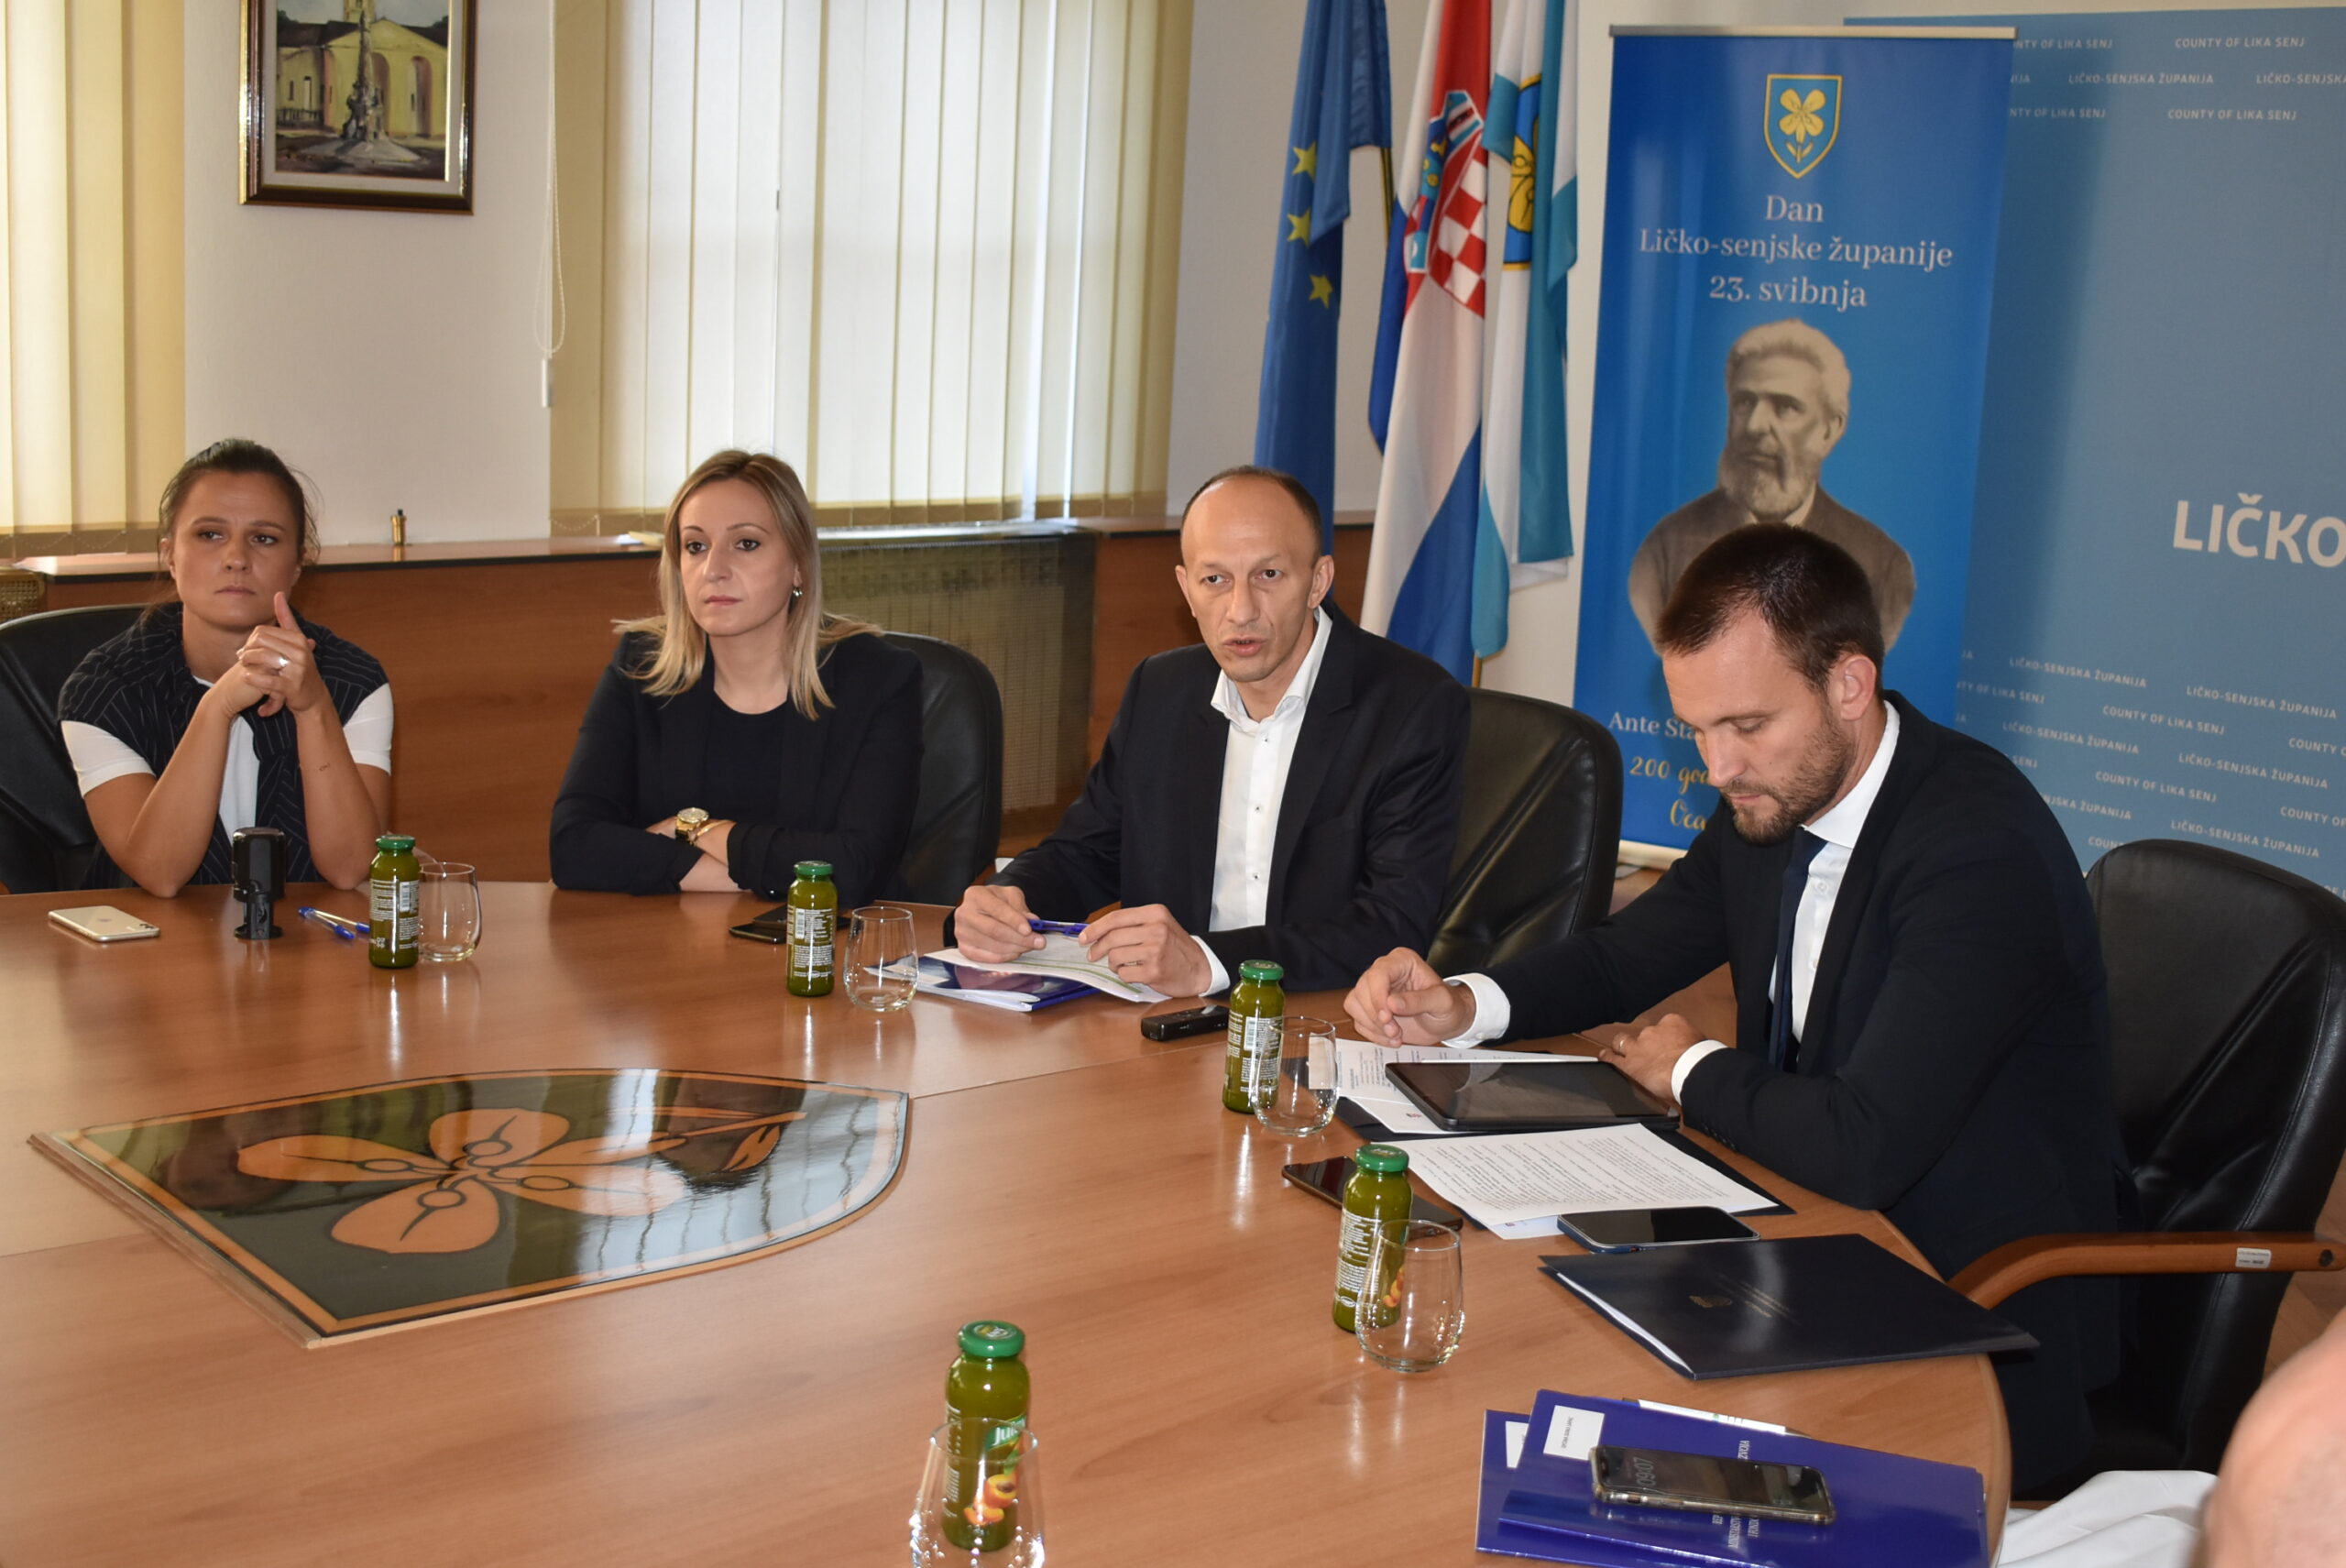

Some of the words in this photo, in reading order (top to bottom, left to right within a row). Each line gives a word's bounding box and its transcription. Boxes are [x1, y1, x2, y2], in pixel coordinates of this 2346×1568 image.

[2041, 39, 2054, 49] OF
[2058, 39, 2082, 49] LIKA
[2087, 38, 2112, 49] SENJ
[2175, 38, 2221, 48] COUNTY
[2225, 38, 2240, 47] OF
[2244, 38, 2271, 48] LIKA
[2275, 37, 2305, 48] SENJ
[2067, 71, 2154, 84] LIČKO-SENJSKA
[2158, 71, 2214, 83] ŽUPANIJA
[2034, 107, 2047, 117] OF
[2051, 108, 2076, 117] LIKA
[2079, 108, 2106, 118] SENJ
[2168, 109, 2214, 119] COUNTY
[2218, 109, 2232, 119] OF
[2236, 110, 2264, 120] LIKA
[2267, 110, 2297, 120] SENJ
[1765, 194, 1824, 223] Dan
[1639, 228, 1822, 264] Ličko-senjske
[1828, 236, 1953, 272] županije
[1709, 275, 1751, 302] 23.
[1759, 277, 1868, 313] svibnja
[2173, 492, 2346, 568] LIČKO
[2009, 656, 2091, 679] LIČKO-SENJSKA
[2095, 668, 2146, 688] ŽUPANIJA
[1992, 685, 2016, 699] LIKA
[2020, 691, 2045, 705] SENJ
[2186, 685, 2276, 709] LIČKO-SENJSKA
[2279, 699, 2338, 719] ŽUPANIJA
[1608, 711, 1660, 734] Ante
[2103, 705, 2147, 721] COUNTY
[2150, 713, 2164, 724] OF
[2167, 717, 2193, 729] LIKA
[2197, 721, 2225, 736] SENJ
[2088, 735, 2139, 754] ŽUPANIJA
[2288, 737, 2337, 754] COUNTY
[1629, 756, 1670, 779] 200
[2012, 755, 2038, 768] SENJ
[2178, 752, 2267, 777] LIČKO-SENJSKA
[2271, 768, 2329, 790] ŽUPANIJA
[2096, 771, 2140, 788] COUNTY
[2143, 780, 2156, 791] OF
[2160, 784, 2186, 797] LIKA
[2188, 788, 2218, 803] SENJ
[2079, 799, 2132, 820] ŽUPANIJA
[2280, 806, 2329, 824] COUNTY
[2170, 819, 2259, 846] LIČKO-SENJSKA
[2263, 836, 2320, 858] ŽUPANIJA
